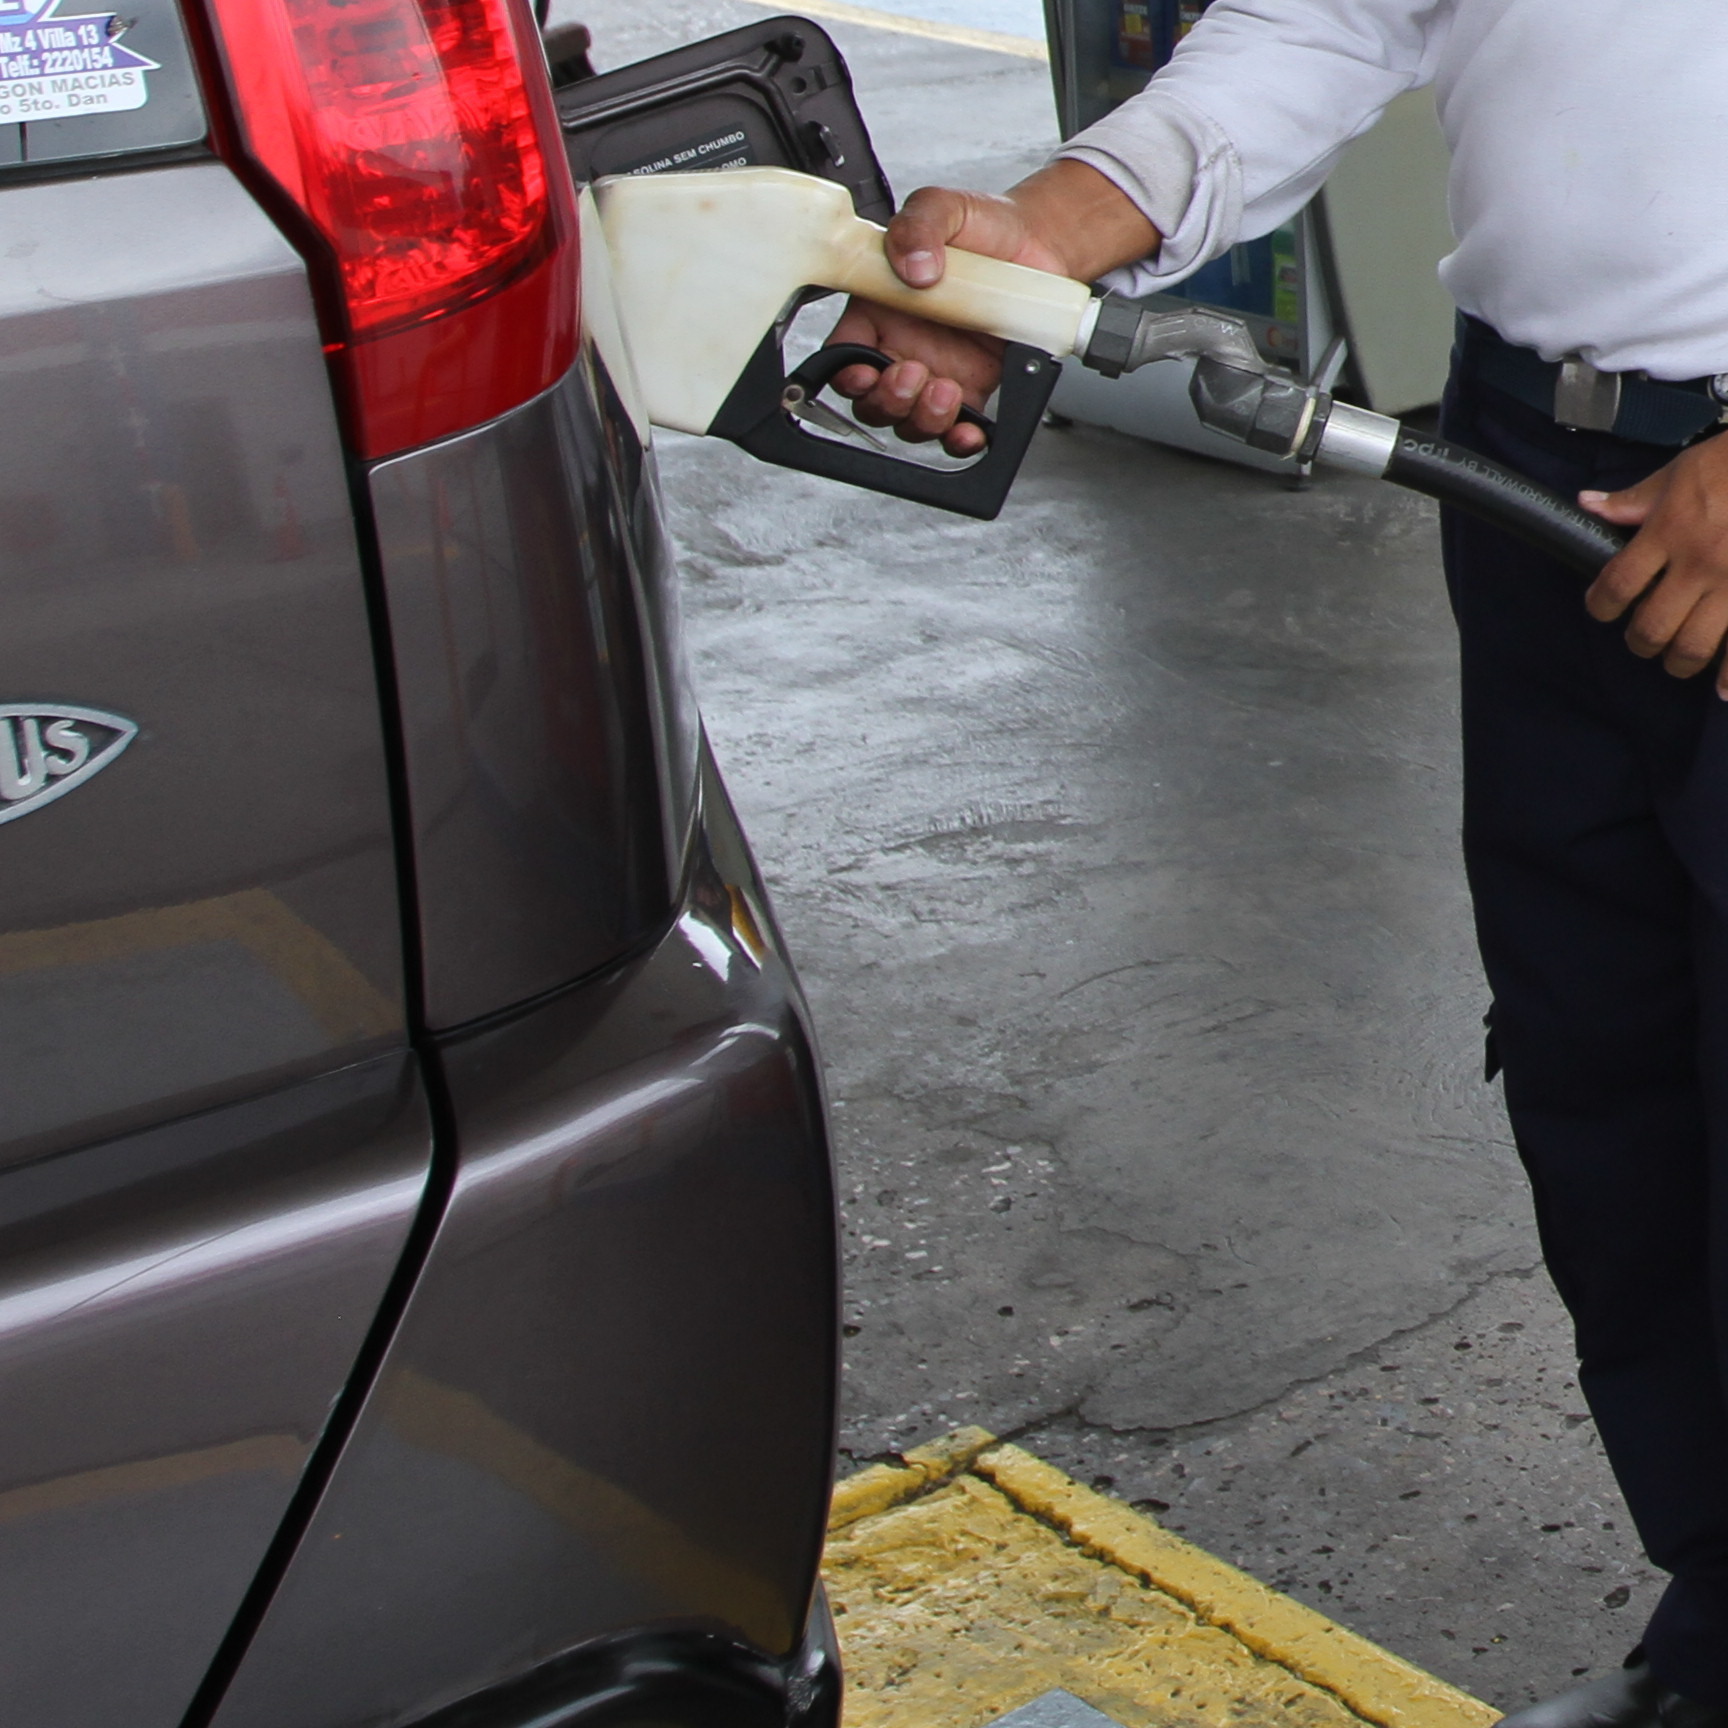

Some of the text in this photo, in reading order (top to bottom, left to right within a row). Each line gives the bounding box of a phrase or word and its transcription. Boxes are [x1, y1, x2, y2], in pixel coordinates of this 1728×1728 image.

[25, 31, 36, 51] 4
[39, 28, 76, 50] Villa
[78, 25, 98, 44] 13
[42, 45, 113, 74] 2220154
[51, 71, 136, 94] MACIAS
[19, 96, 61, 114] 5to.
[68, 92, 108, 109] Dan
[673, 148, 698, 165] SEM
[698, 130, 746, 155] CHUMBO
[1455, 453, 1479, 474] BY
[1477, 461, 1558, 514] HARDWALL
[1556, 504, 1605, 541] ULTRA
